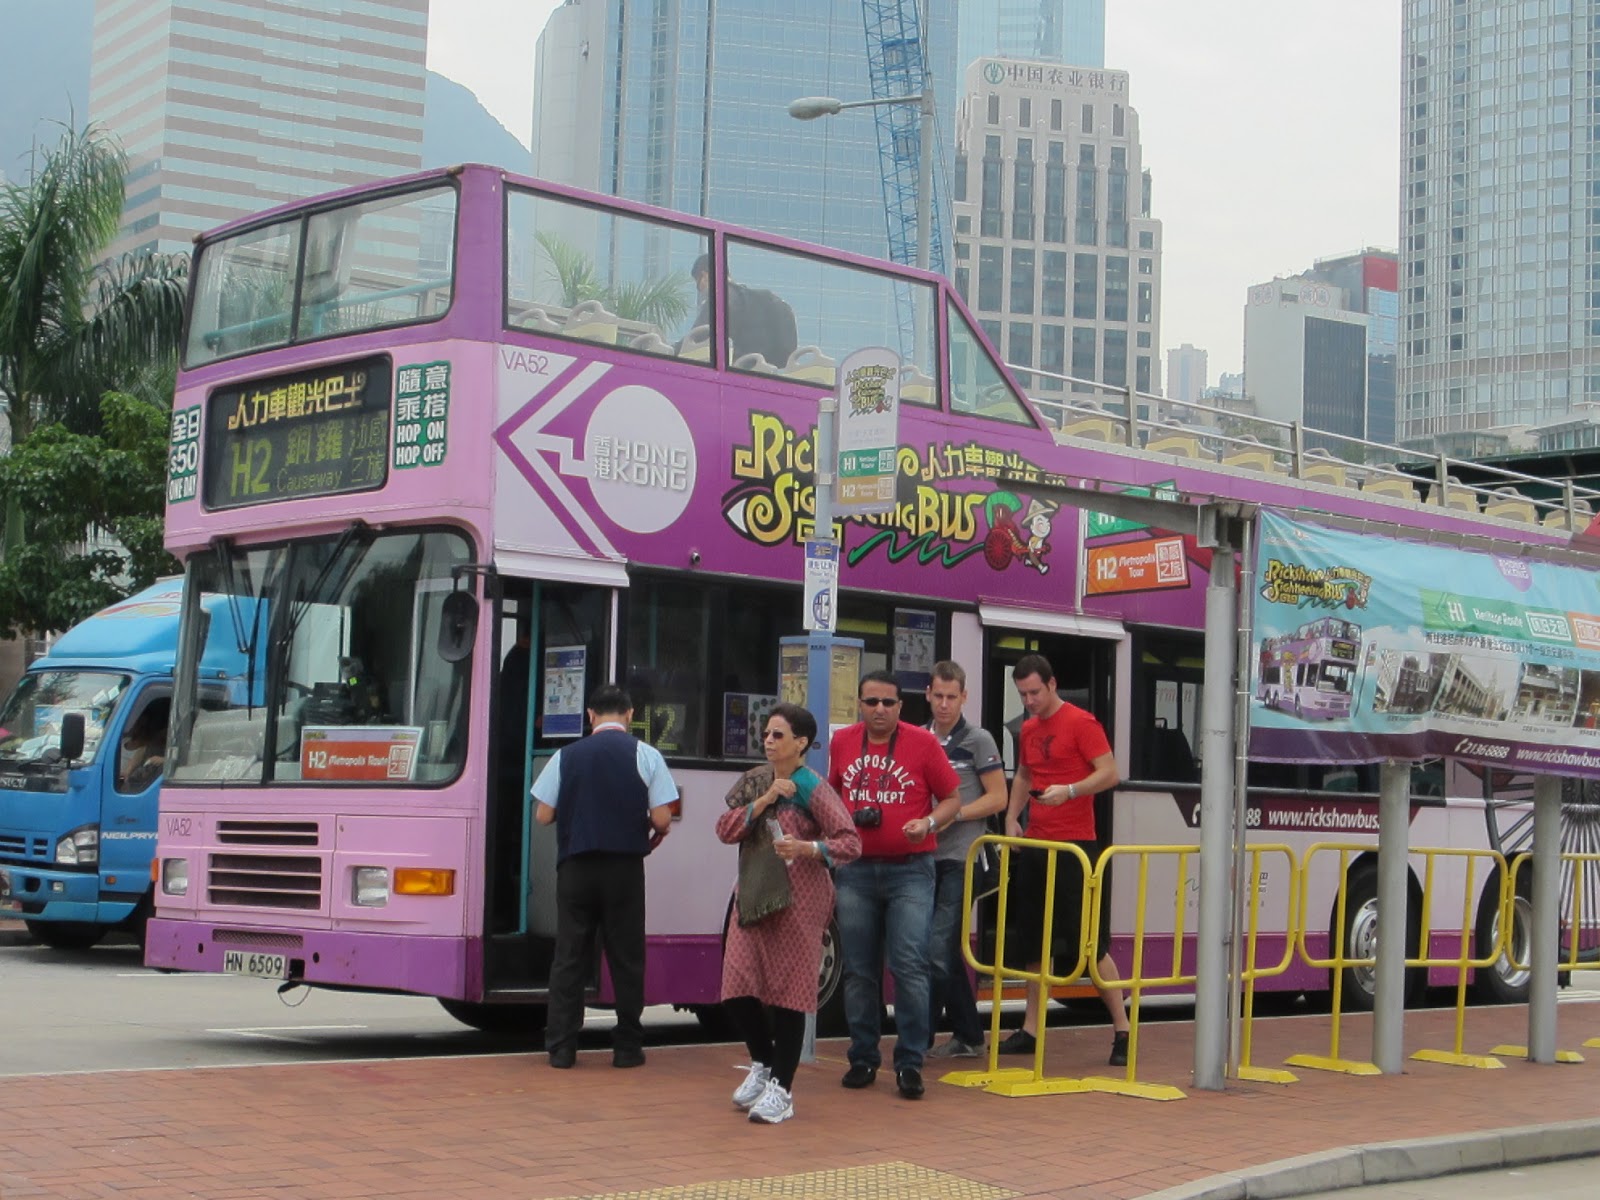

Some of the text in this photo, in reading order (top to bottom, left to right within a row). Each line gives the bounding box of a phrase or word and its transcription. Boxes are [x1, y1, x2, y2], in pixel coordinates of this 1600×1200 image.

[1007, 64, 1126, 92] 中国农业银行
[501, 349, 549, 376] VA52
[399, 366, 448, 393] 隨意
[228, 372, 367, 430] 人力車觀光巴士
[398, 393, 447, 420] 乘搭
[172, 409, 200, 442] 全日
[397, 421, 445, 443] HOP ON
[396, 444, 445, 466] HOP OFF
[614, 437, 687, 468] HONG
[230, 438, 272, 497] H2
[613, 459, 687, 490] KONG
[276, 468, 342, 493] Causeway
[842, 485, 856, 498] H2
[917, 485, 987, 541] BUS
[1097, 557, 1117, 580] H2
[1119, 553, 1155, 567] Metropolis
[1264, 558, 1325, 583] Rickshaw
[1323, 581, 1346, 600] BUS
[308, 751, 327, 769] H2
[843, 754, 915, 789] AEROPOSTALE
[877, 791, 906, 804] DEPT.
[166, 818, 192, 837] VA52
[226, 954, 283, 974] HN 6509
